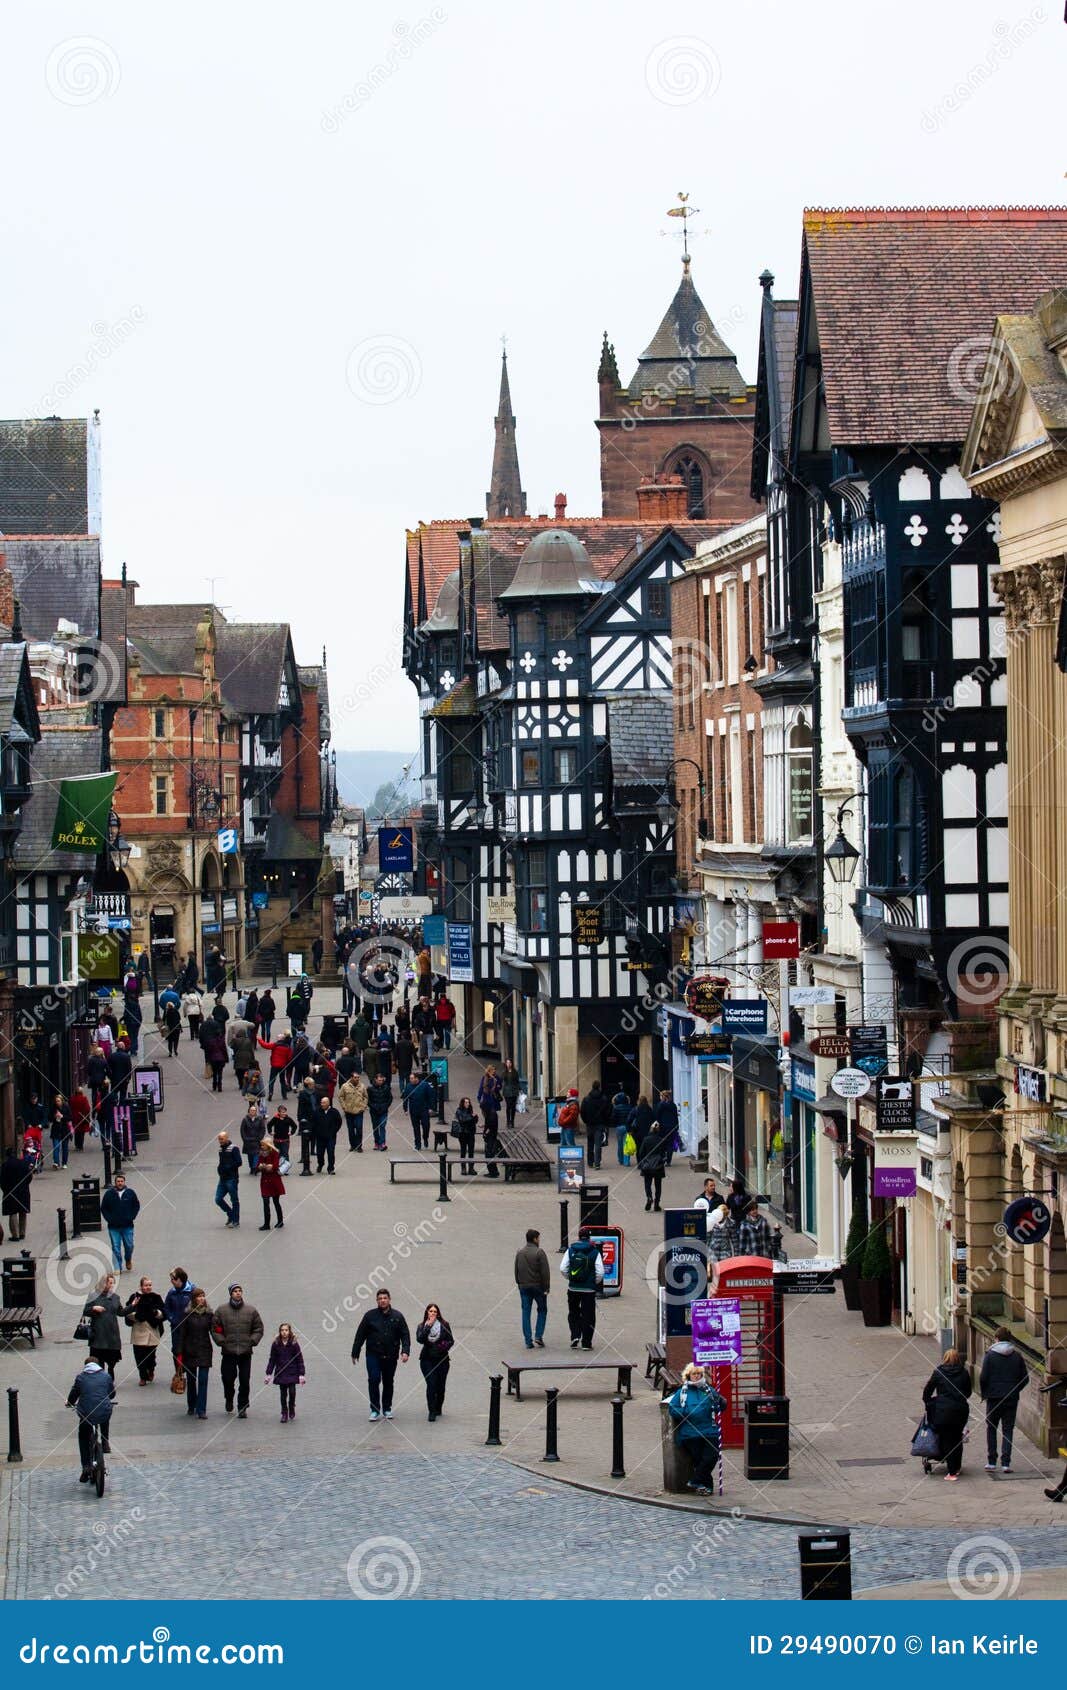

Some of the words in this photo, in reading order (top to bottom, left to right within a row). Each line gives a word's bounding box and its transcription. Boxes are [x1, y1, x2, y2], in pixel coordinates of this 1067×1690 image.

[58, 833, 97, 846] ROLEX
[577, 918, 598, 926] Boot
[580, 927, 596, 935] Inn
[729, 1008, 764, 1017] Carphone
[820, 1038, 849, 1046] BELLA
[819, 1046, 850, 1054] ITALIA
[881, 1116, 912, 1124] TAILORS
[881, 1147, 912, 1156] MOSS
[672, 1252, 701, 1262] Rows
